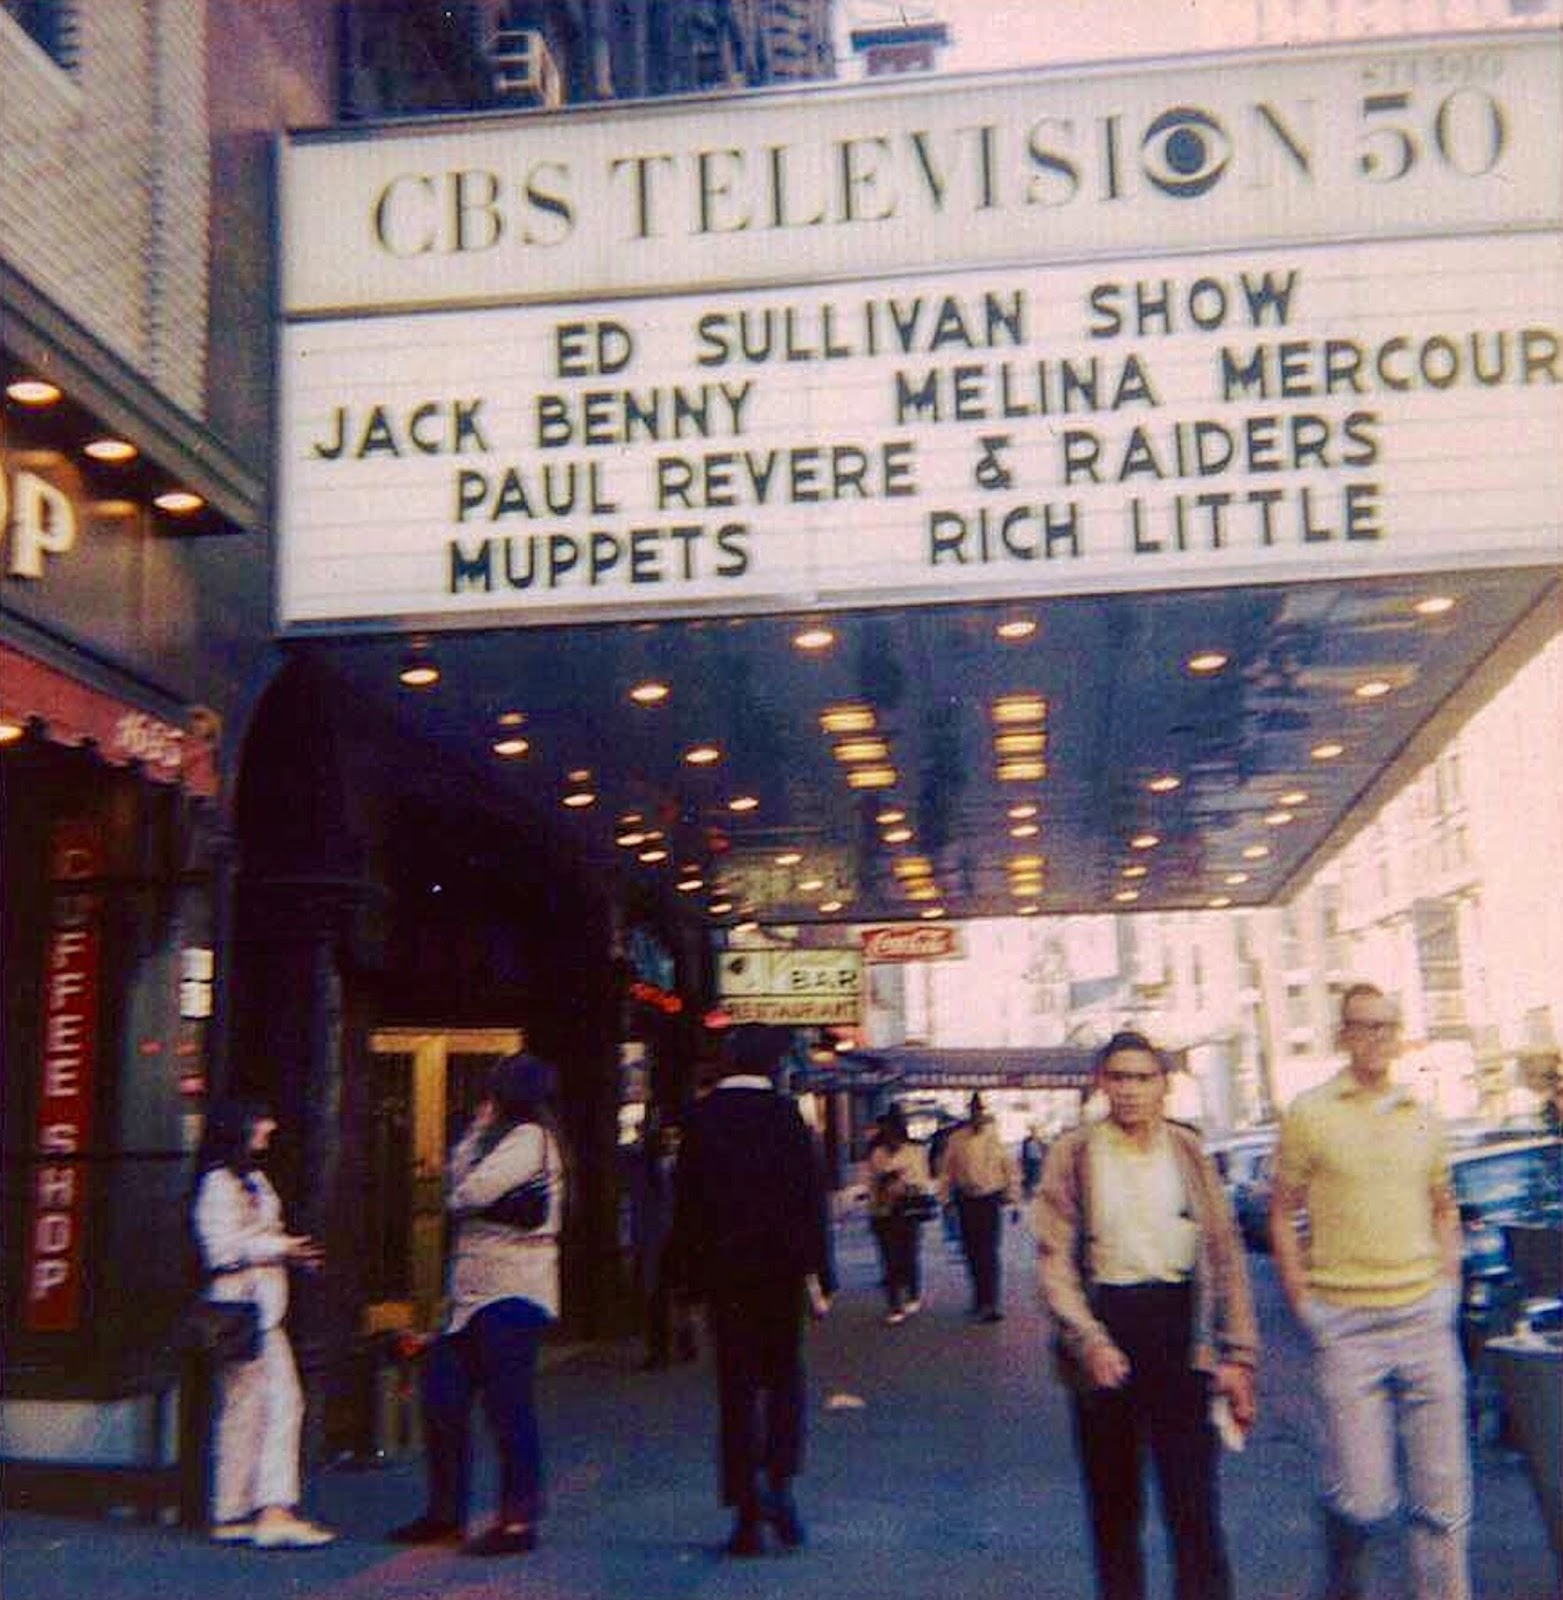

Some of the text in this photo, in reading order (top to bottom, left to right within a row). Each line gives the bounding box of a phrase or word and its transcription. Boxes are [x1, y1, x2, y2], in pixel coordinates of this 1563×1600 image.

[372, 162, 576, 258] CBS
[1360, 85, 1508, 181] 50
[556, 271, 1296, 378] ED SULLIVAN SHOW
[313, 400, 488, 461] JACK
[537, 381, 752, 450] BENNY
[895, 355, 1158, 425] MELINA
[457, 411, 1379, 523] PAUL REVERE & RAIDERS
[449, 484, 1381, 594] MUPPETS RICH LITTLE
[791, 968, 858, 992] BAR
[34, 1122, 80, 1297] SHOP
